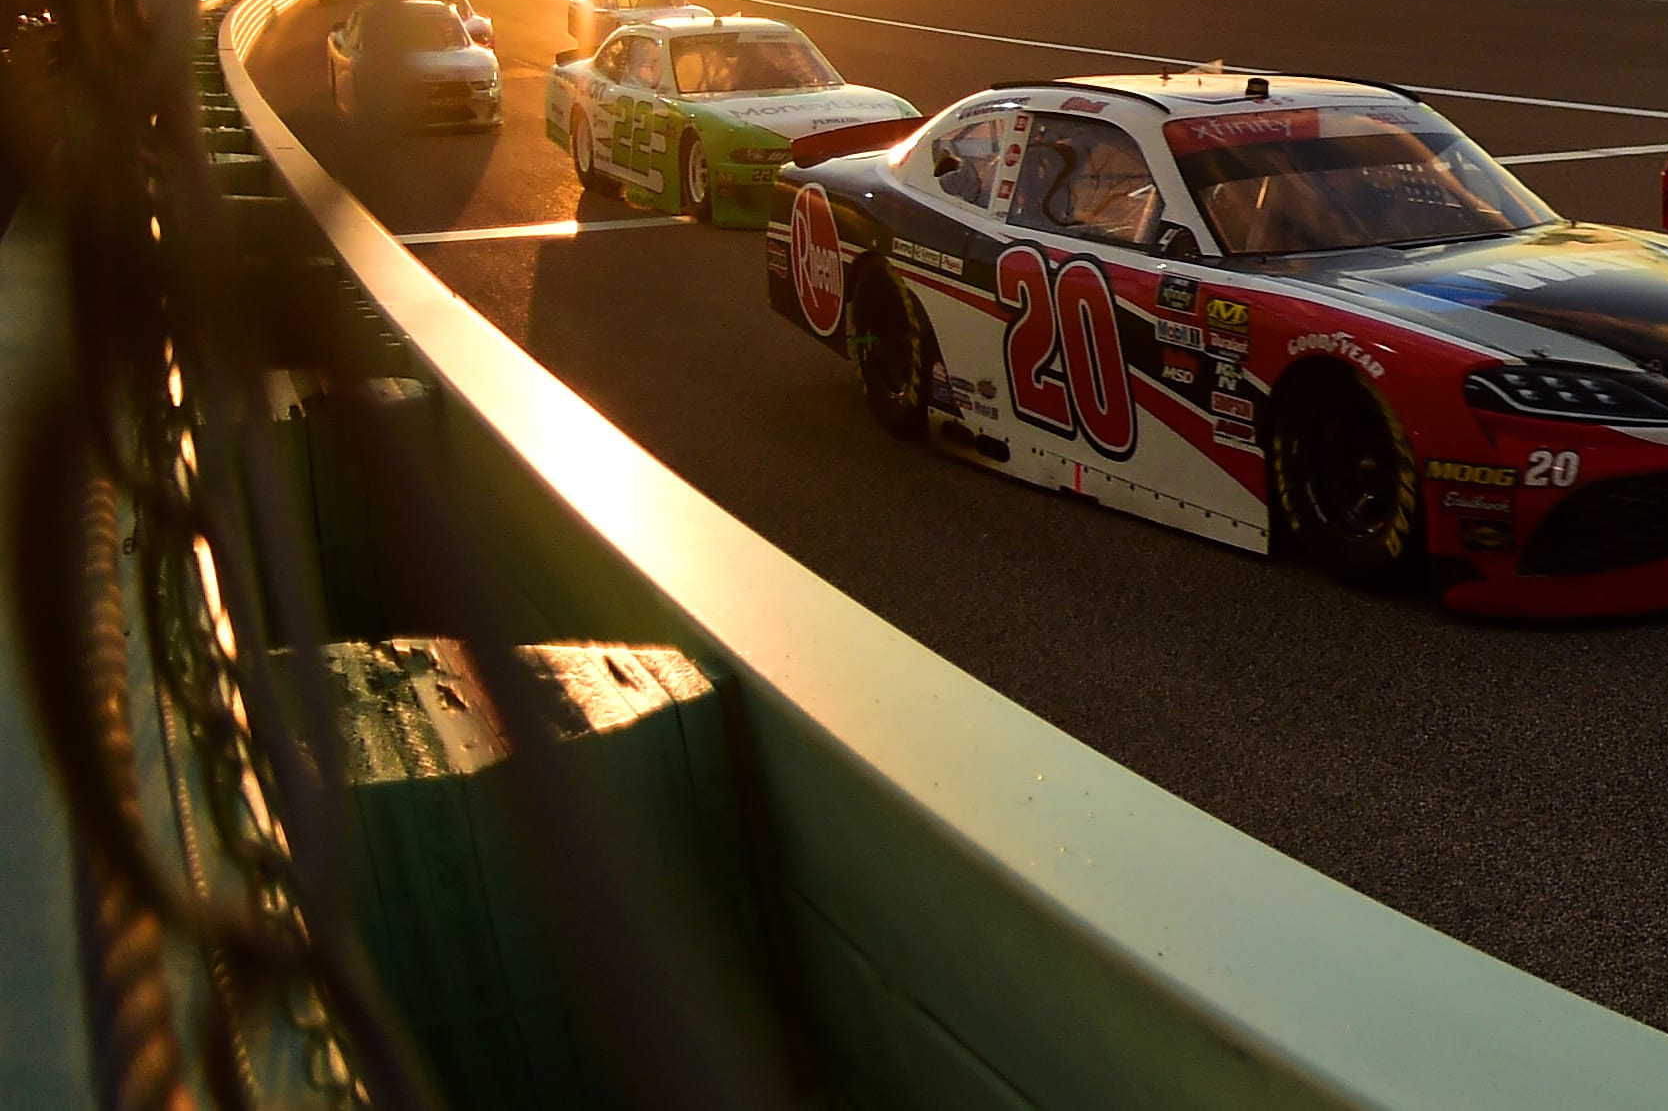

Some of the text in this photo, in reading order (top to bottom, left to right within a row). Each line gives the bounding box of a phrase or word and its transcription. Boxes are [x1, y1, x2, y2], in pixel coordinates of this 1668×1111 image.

[730, 97, 900, 119] MoneyLion
[612, 95, 654, 177] 22
[1190, 117, 1293, 143] xfinity
[753, 169, 774, 182] 22
[795, 189, 841, 309] Rheem
[997, 240, 1138, 462] 20
[1426, 460, 1517, 486] MOOG
[1524, 450, 1581, 487] 20
